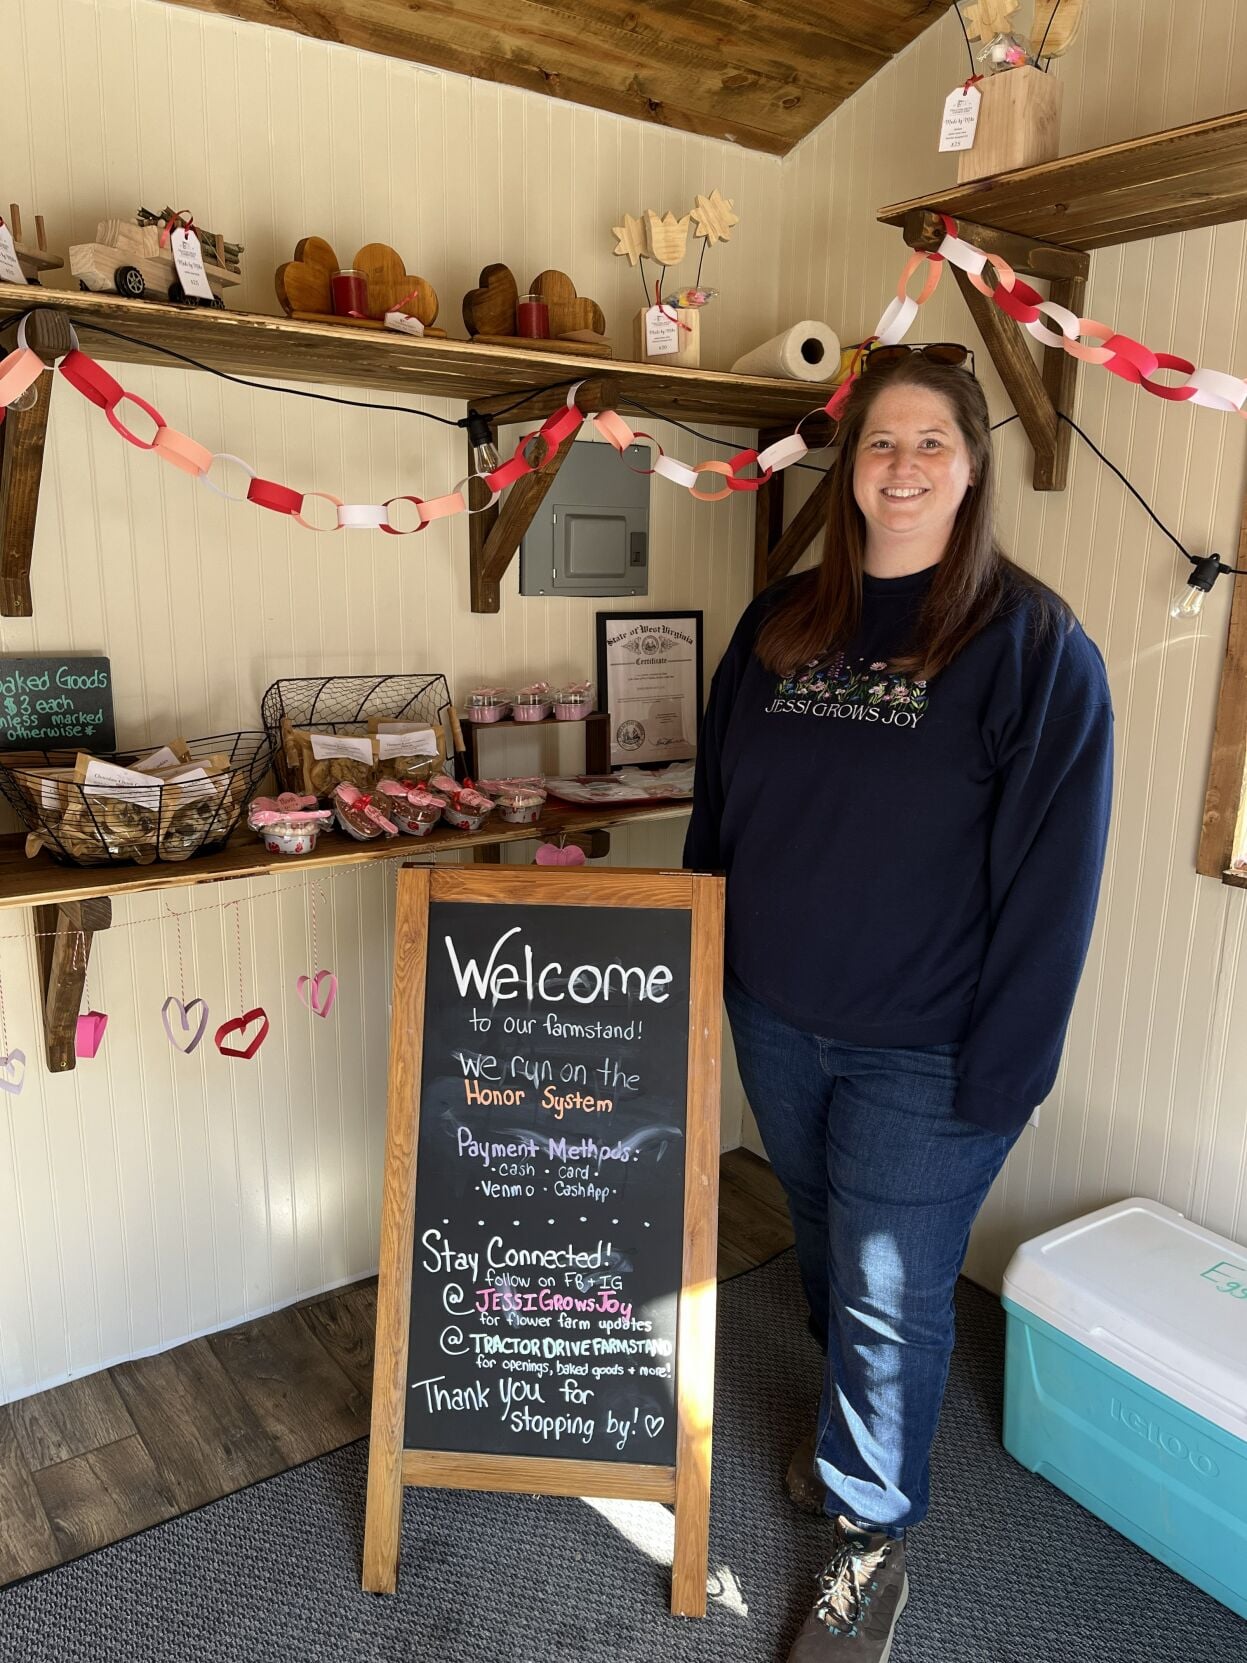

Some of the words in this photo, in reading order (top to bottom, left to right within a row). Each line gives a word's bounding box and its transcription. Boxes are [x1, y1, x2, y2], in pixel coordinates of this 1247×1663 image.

[606, 632, 628, 647] State
[630, 627, 640, 636] of
[639, 624, 661, 634] West
[661, 624, 694, 645] Virginia
[635, 657, 668, 666] Certificate
[0, 670, 50, 696] aked
[56, 666, 108, 690] Goods
[36, 694, 74, 714] each
[51, 708, 104, 725] marked
[765, 699, 812, 715] JESSI
[812, 702, 880, 722] GROWS
[881, 709, 924, 729] JOY
[444, 926, 673, 1006] Welcome
[468, 1008, 492, 1032] to
[503, 1016, 537, 1035] our
[543, 1013, 643, 1041] farmstand!
[511, 1055, 553, 1088] run
[560, 1063, 587, 1085] on
[596, 1057, 640, 1091] the
[464, 1078, 525, 1106] Honor
[541, 1085, 613, 1120] System
[457, 1126, 539, 1167] Payment
[548, 1137, 640, 1164] Methods:
[481, 1180, 535, 1198] Venmo
[421, 1228, 479, 1284] Stay
[487, 1236, 612, 1269] Connected!
[485, 1269, 531, 1288] follow
[538, 1276, 556, 1288] on
[479, 1312, 501, 1327] for
[506, 1315, 552, 1329] flower
[557, 1313, 591, 1330] farm
[599, 1316, 653, 1338] updates
[475, 1354, 496, 1369] for
[502, 1358, 554, 1379] openings,
[557, 1360, 588, 1376] baked
[591, 1364, 625, 1380] goods
[639, 1362, 672, 1380] more!
[411, 1375, 490, 1414] Thank
[558, 1379, 595, 1405] for
[606, 1407, 640, 1451] by!
[1110, 1397, 1221, 1479] IGLOO
